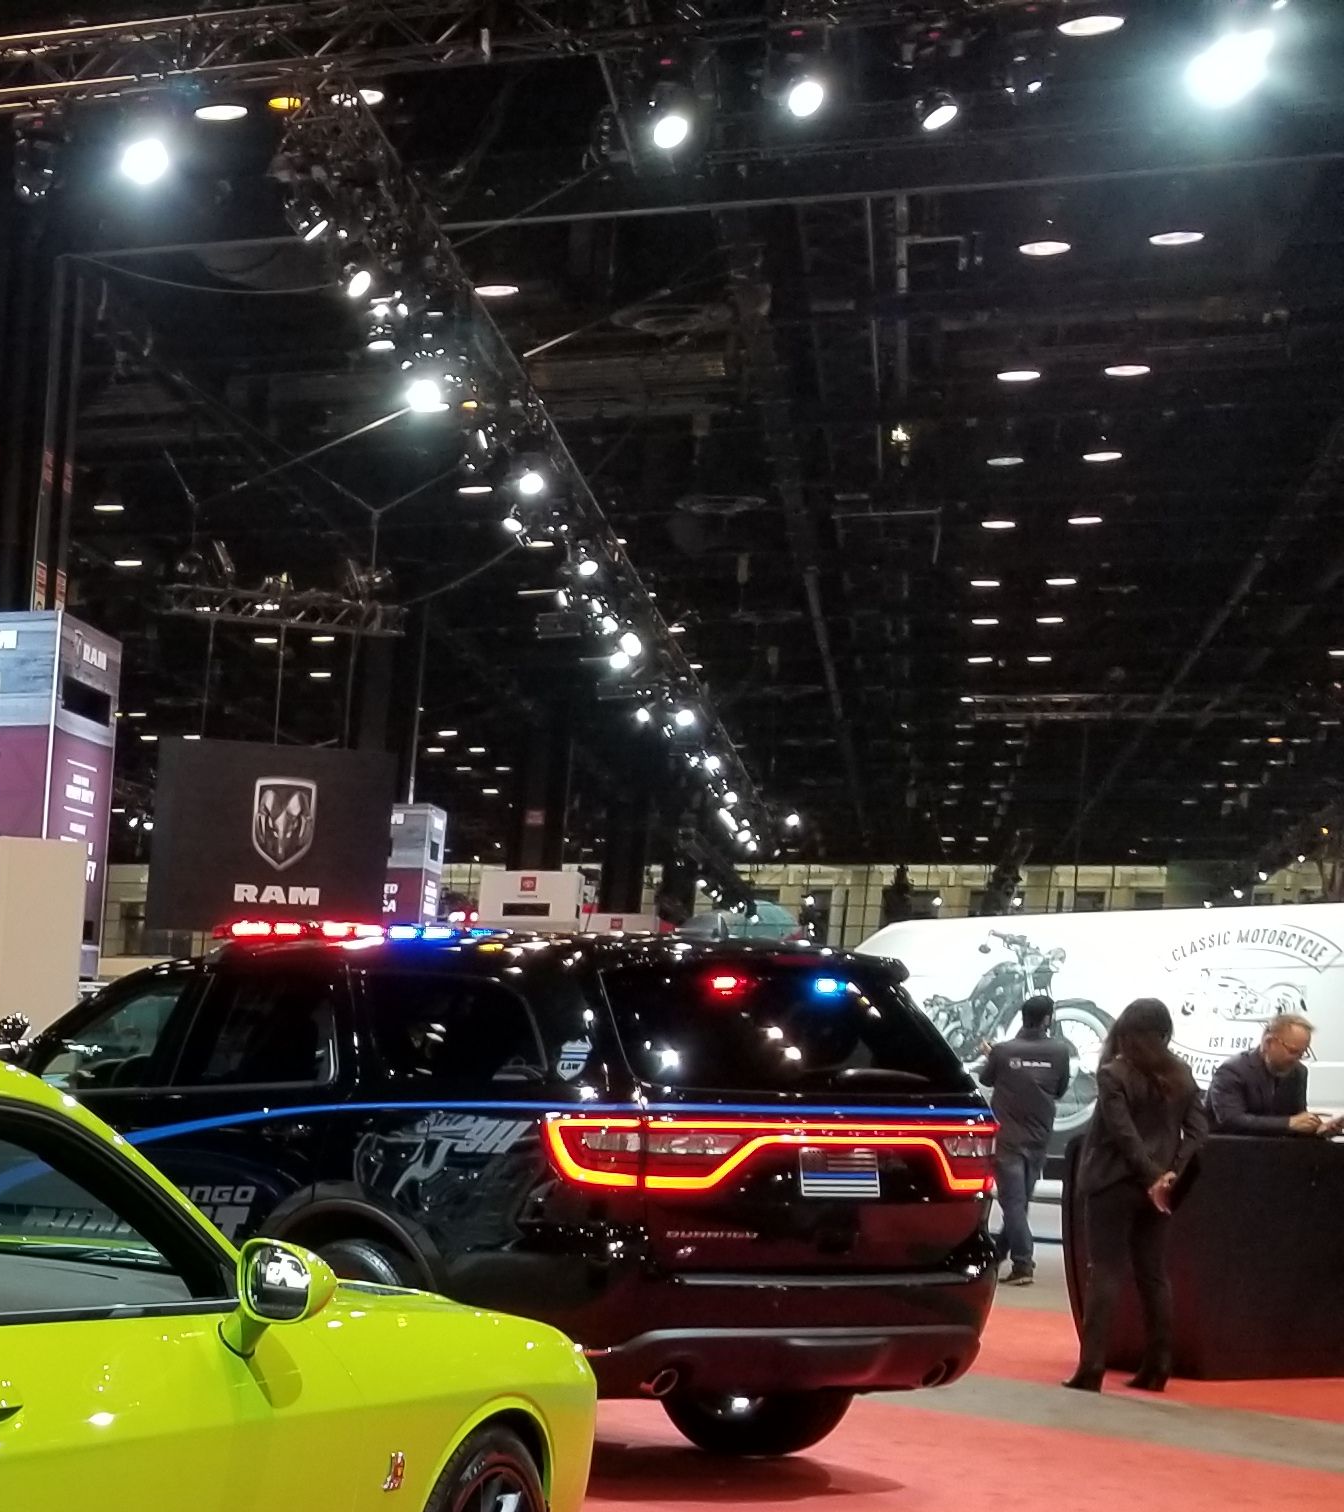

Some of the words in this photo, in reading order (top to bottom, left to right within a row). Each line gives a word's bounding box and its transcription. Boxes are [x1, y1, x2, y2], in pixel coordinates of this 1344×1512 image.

[82, 643, 108, 672] RAM
[233, 883, 320, 906] RAM
[1171, 931, 1231, 962] CLASSIC
[1236, 928, 1328, 962] MOTORCYCLE
[1208, 1037, 1224, 1048] EST
[560, 1062, 581, 1071] LAW
